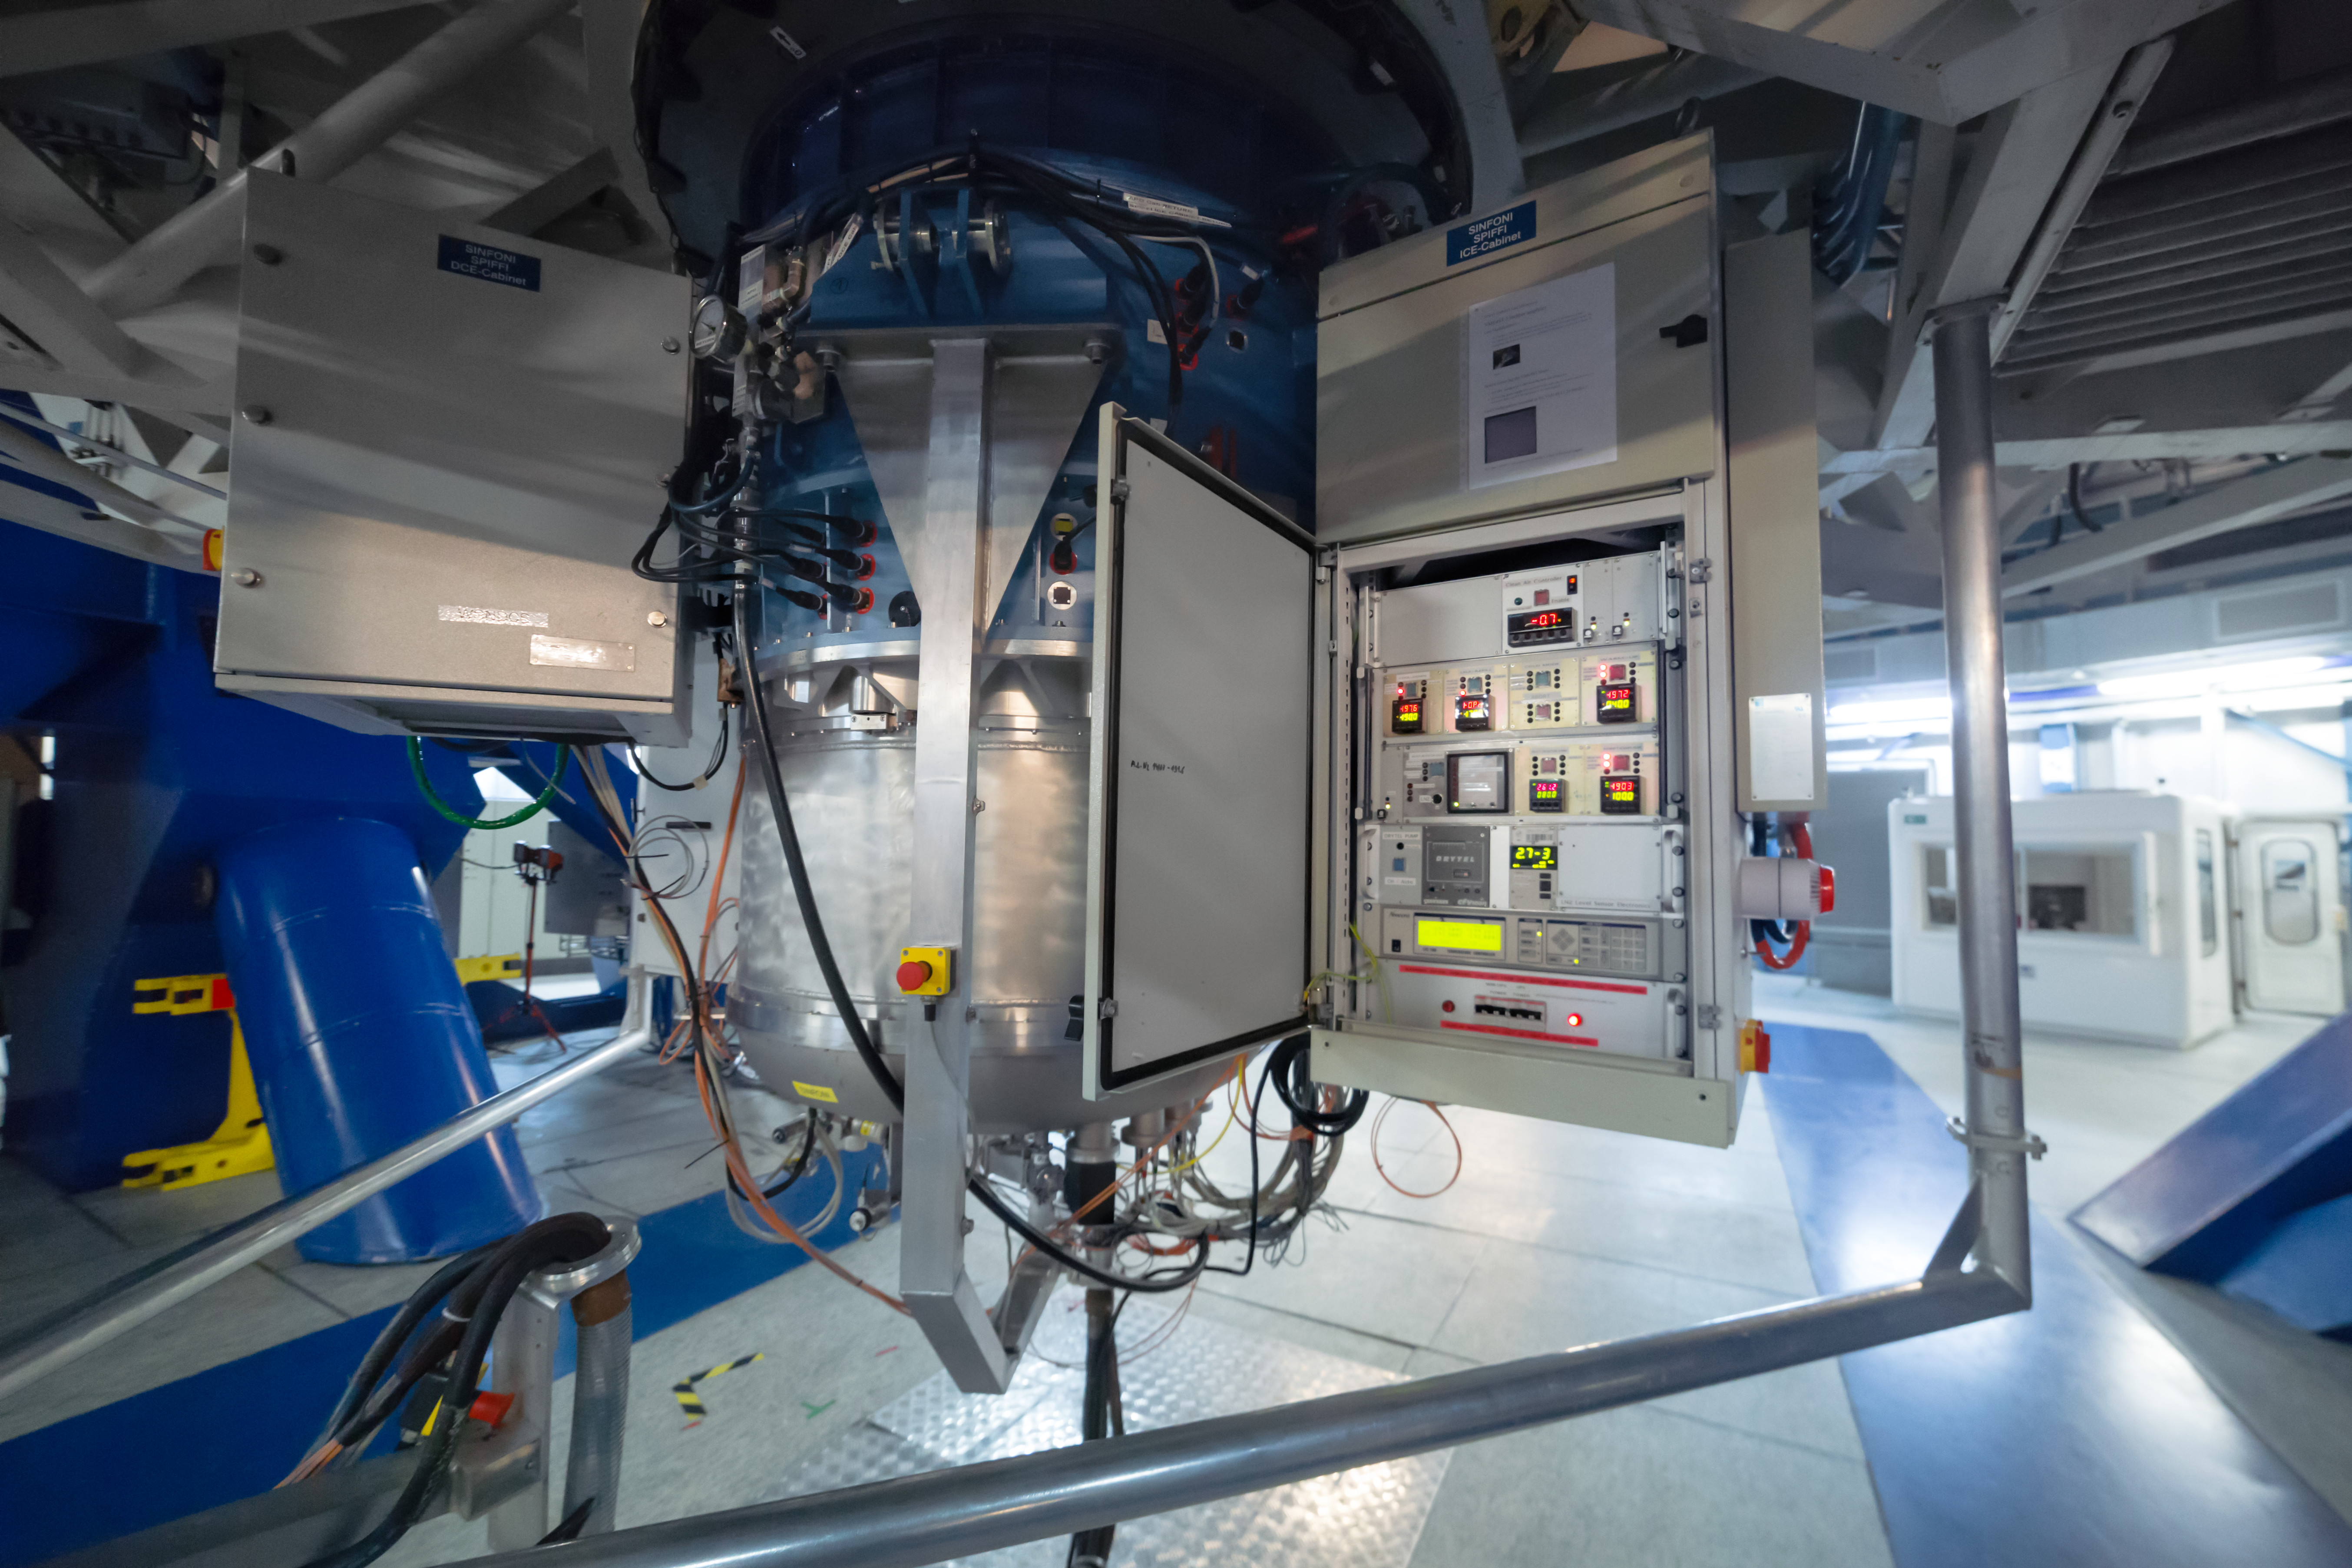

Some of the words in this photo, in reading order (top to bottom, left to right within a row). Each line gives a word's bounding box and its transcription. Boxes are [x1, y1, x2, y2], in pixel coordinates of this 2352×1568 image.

[848, 225, 859, 240] Cab
[1469, 212, 1512, 235] SINFONI
[1474, 225, 1507, 244] SPIFFI
[1460, 231, 1521, 258] ICE-Cabinet
[466, 245, 516, 263] SINFONI
[743, 248, 762, 261] RETURN
[471, 256, 509, 271] SPIFFI
[451, 261, 526, 285] DCE-Cabinet
[695, 336, 715, 347] RETURN
